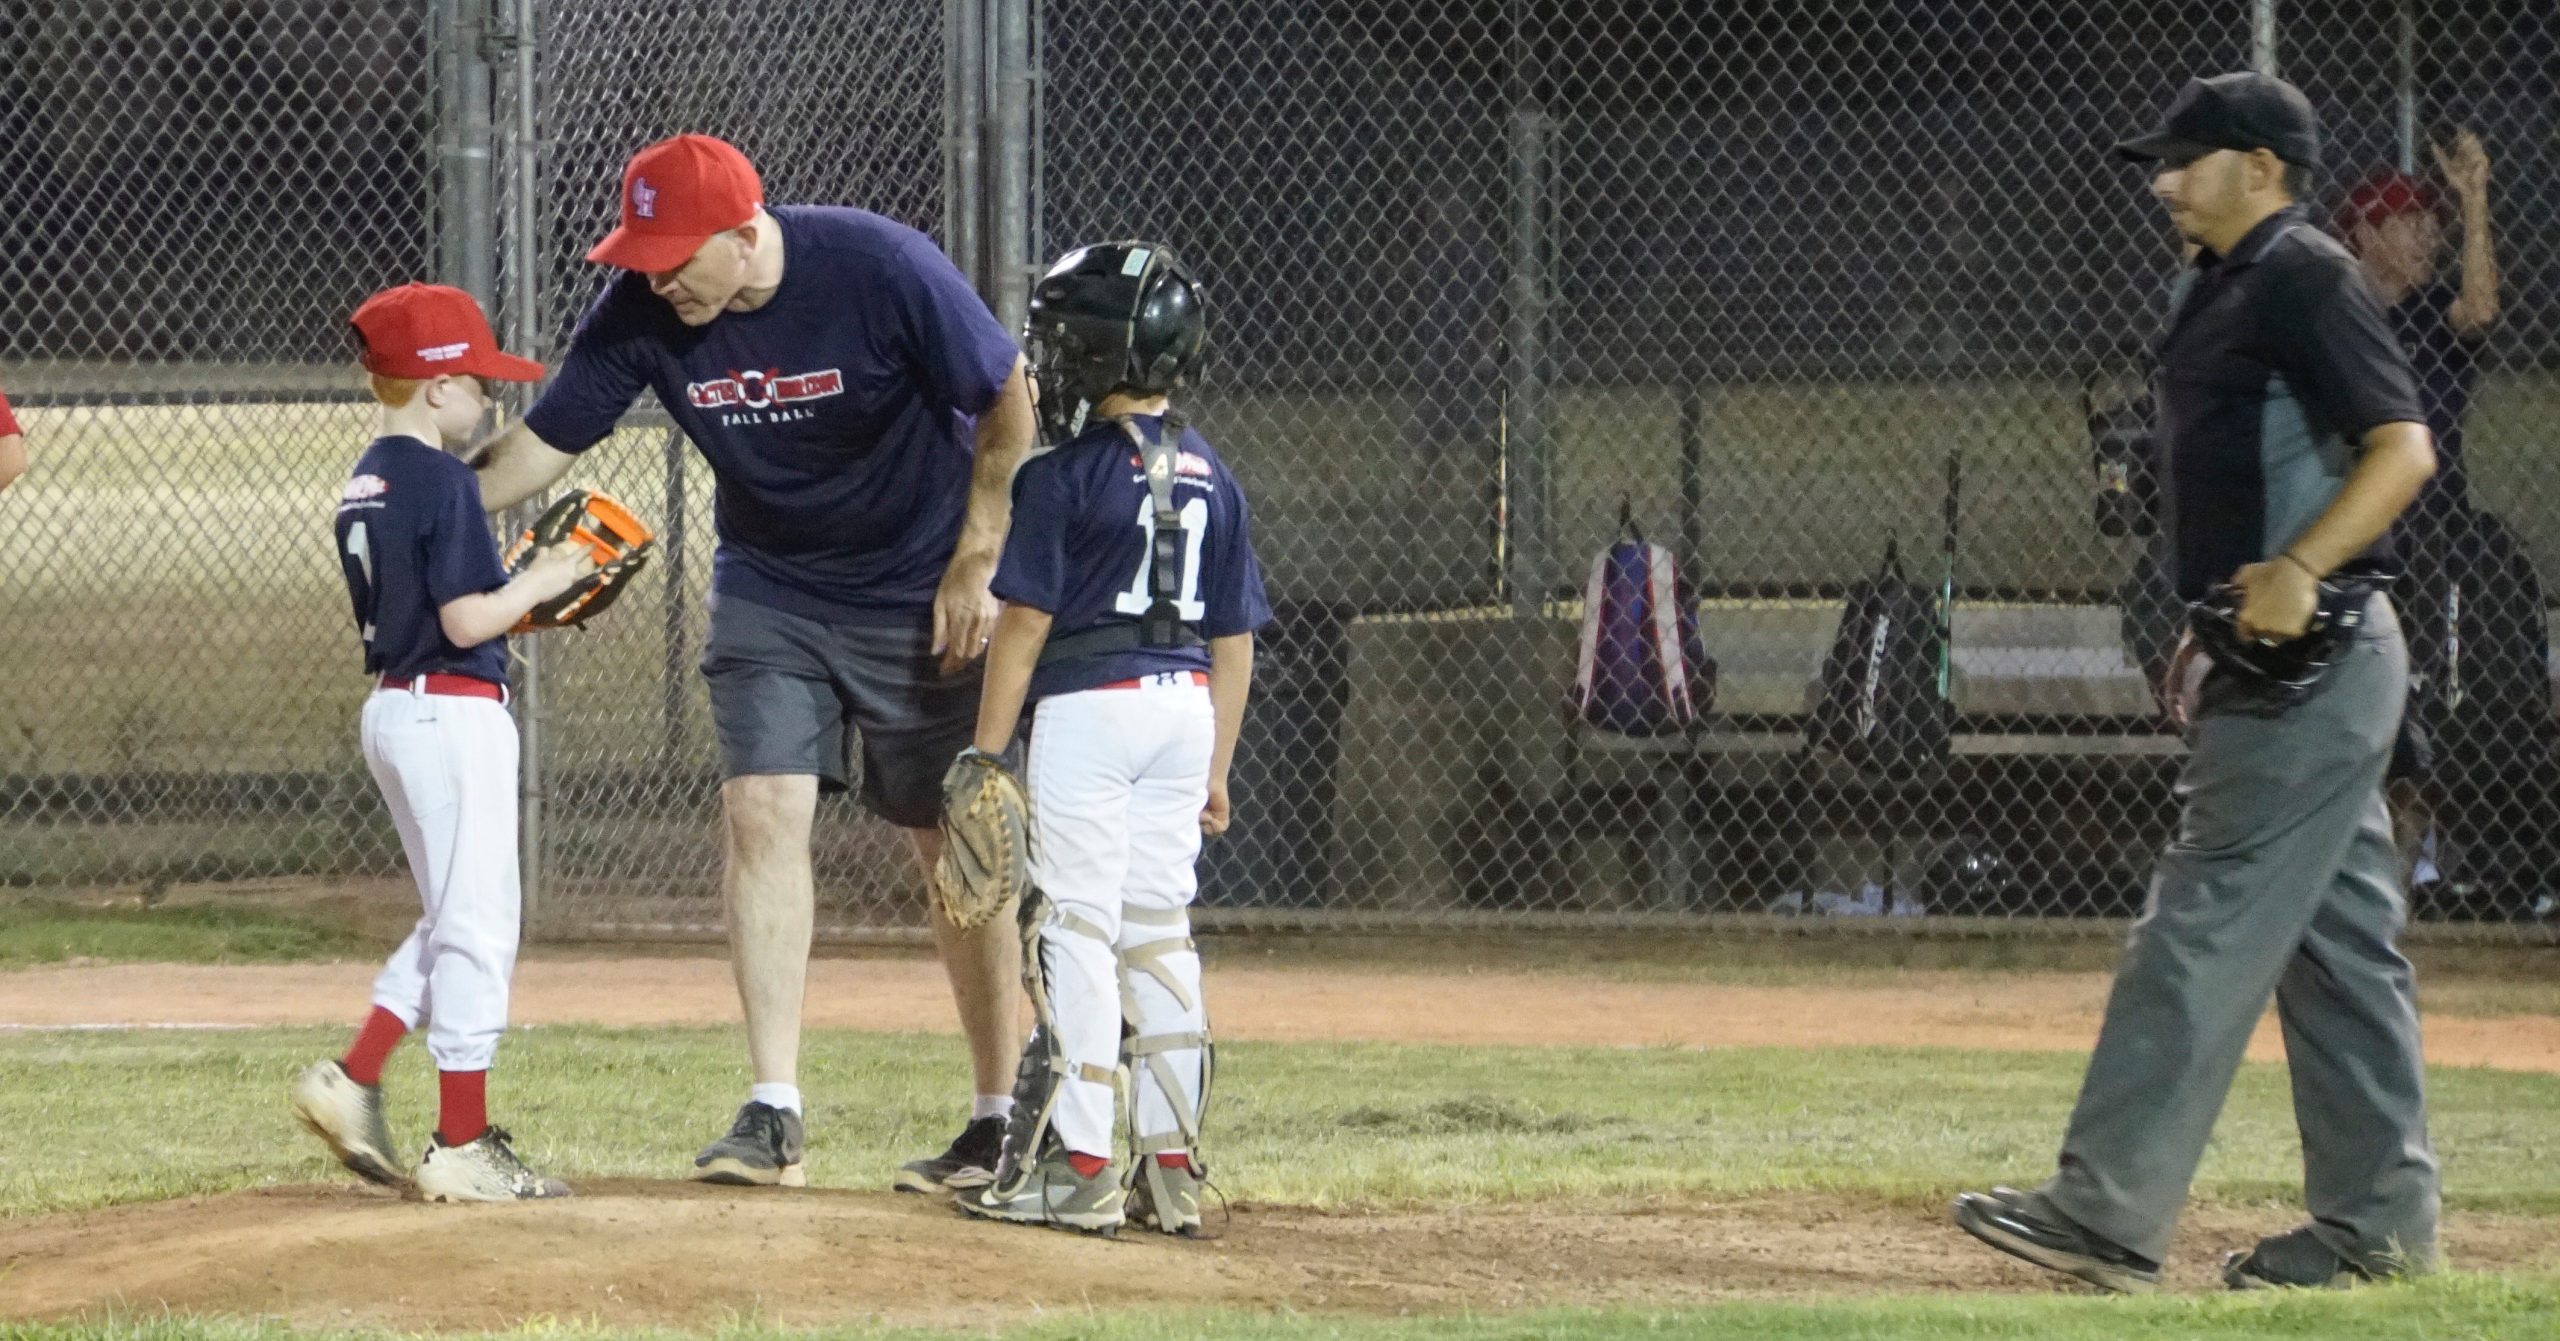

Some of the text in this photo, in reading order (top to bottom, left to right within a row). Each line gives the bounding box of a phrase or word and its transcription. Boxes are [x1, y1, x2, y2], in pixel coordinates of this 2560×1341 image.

[722, 409, 815, 426] FALL BALL
[1116, 493, 1209, 621] 11
